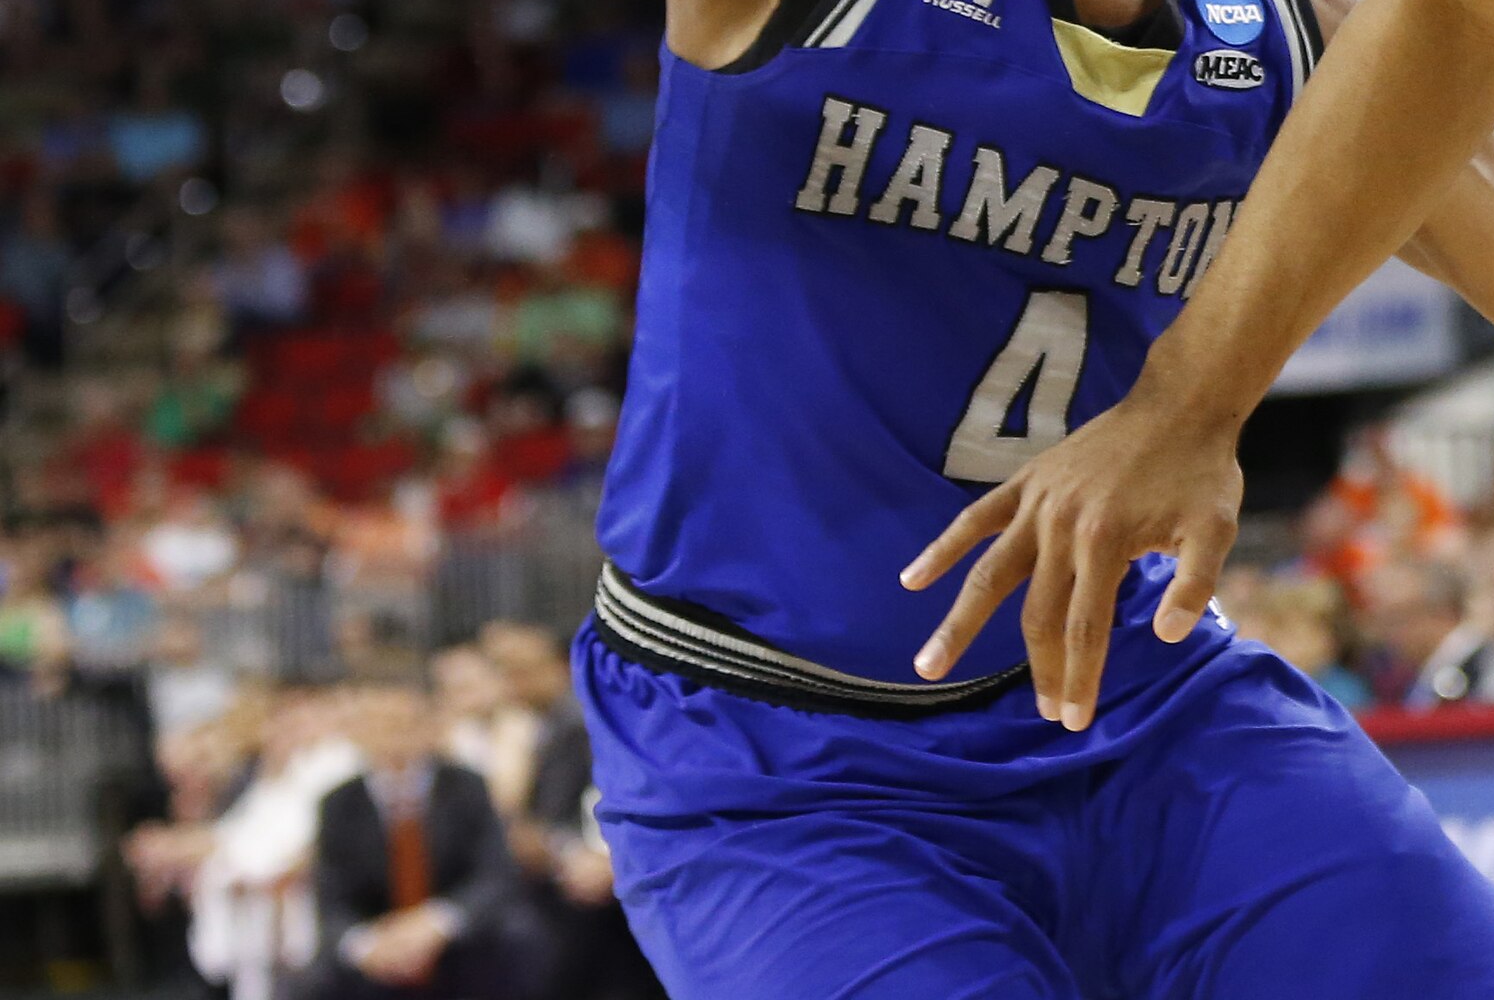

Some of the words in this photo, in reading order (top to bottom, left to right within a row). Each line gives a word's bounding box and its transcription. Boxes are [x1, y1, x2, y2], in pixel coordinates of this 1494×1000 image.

[1206, 3, 1263, 24] NCAA
[1200, 55, 1262, 82] MEAC
[942, 290, 1088, 483] 4
